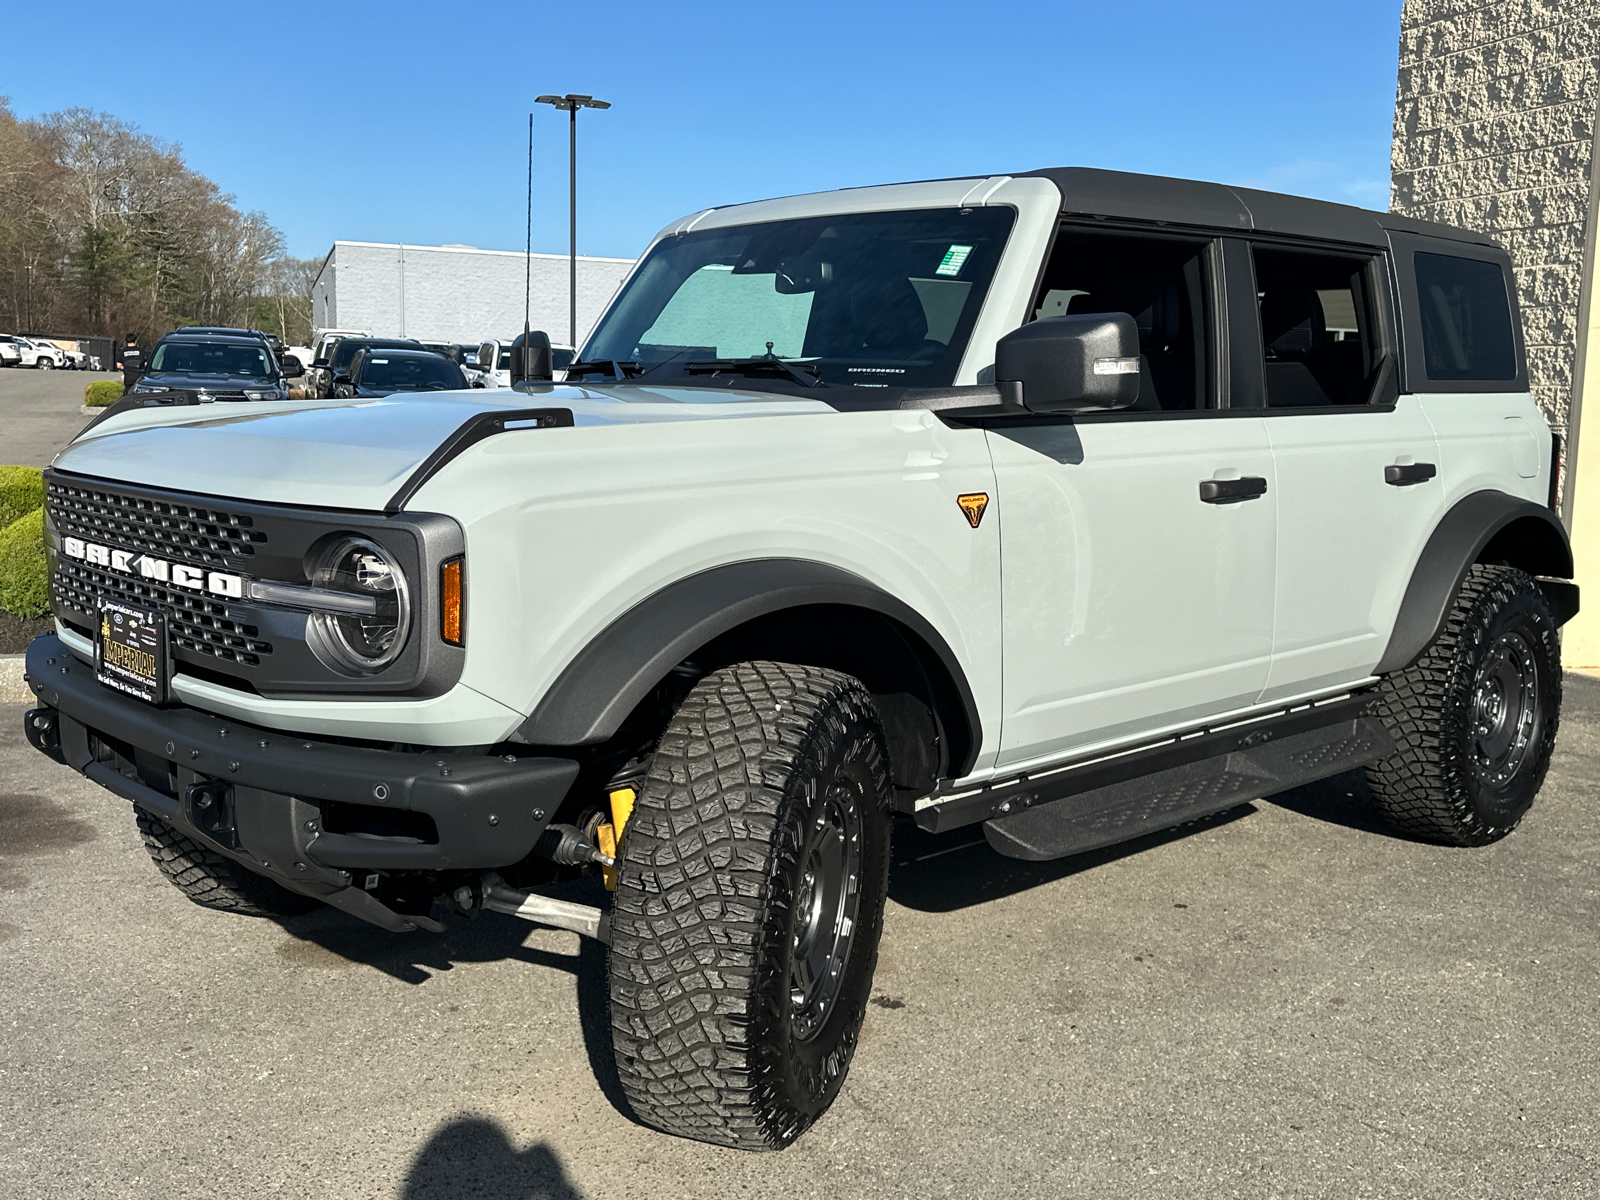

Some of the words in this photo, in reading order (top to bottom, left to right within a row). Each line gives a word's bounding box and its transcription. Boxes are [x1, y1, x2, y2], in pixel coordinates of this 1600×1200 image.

[64, 536, 242, 599] BRONCO
[103, 637, 156, 680] IMPERIAL
[103, 661, 157, 687] www.imperialcars.com
